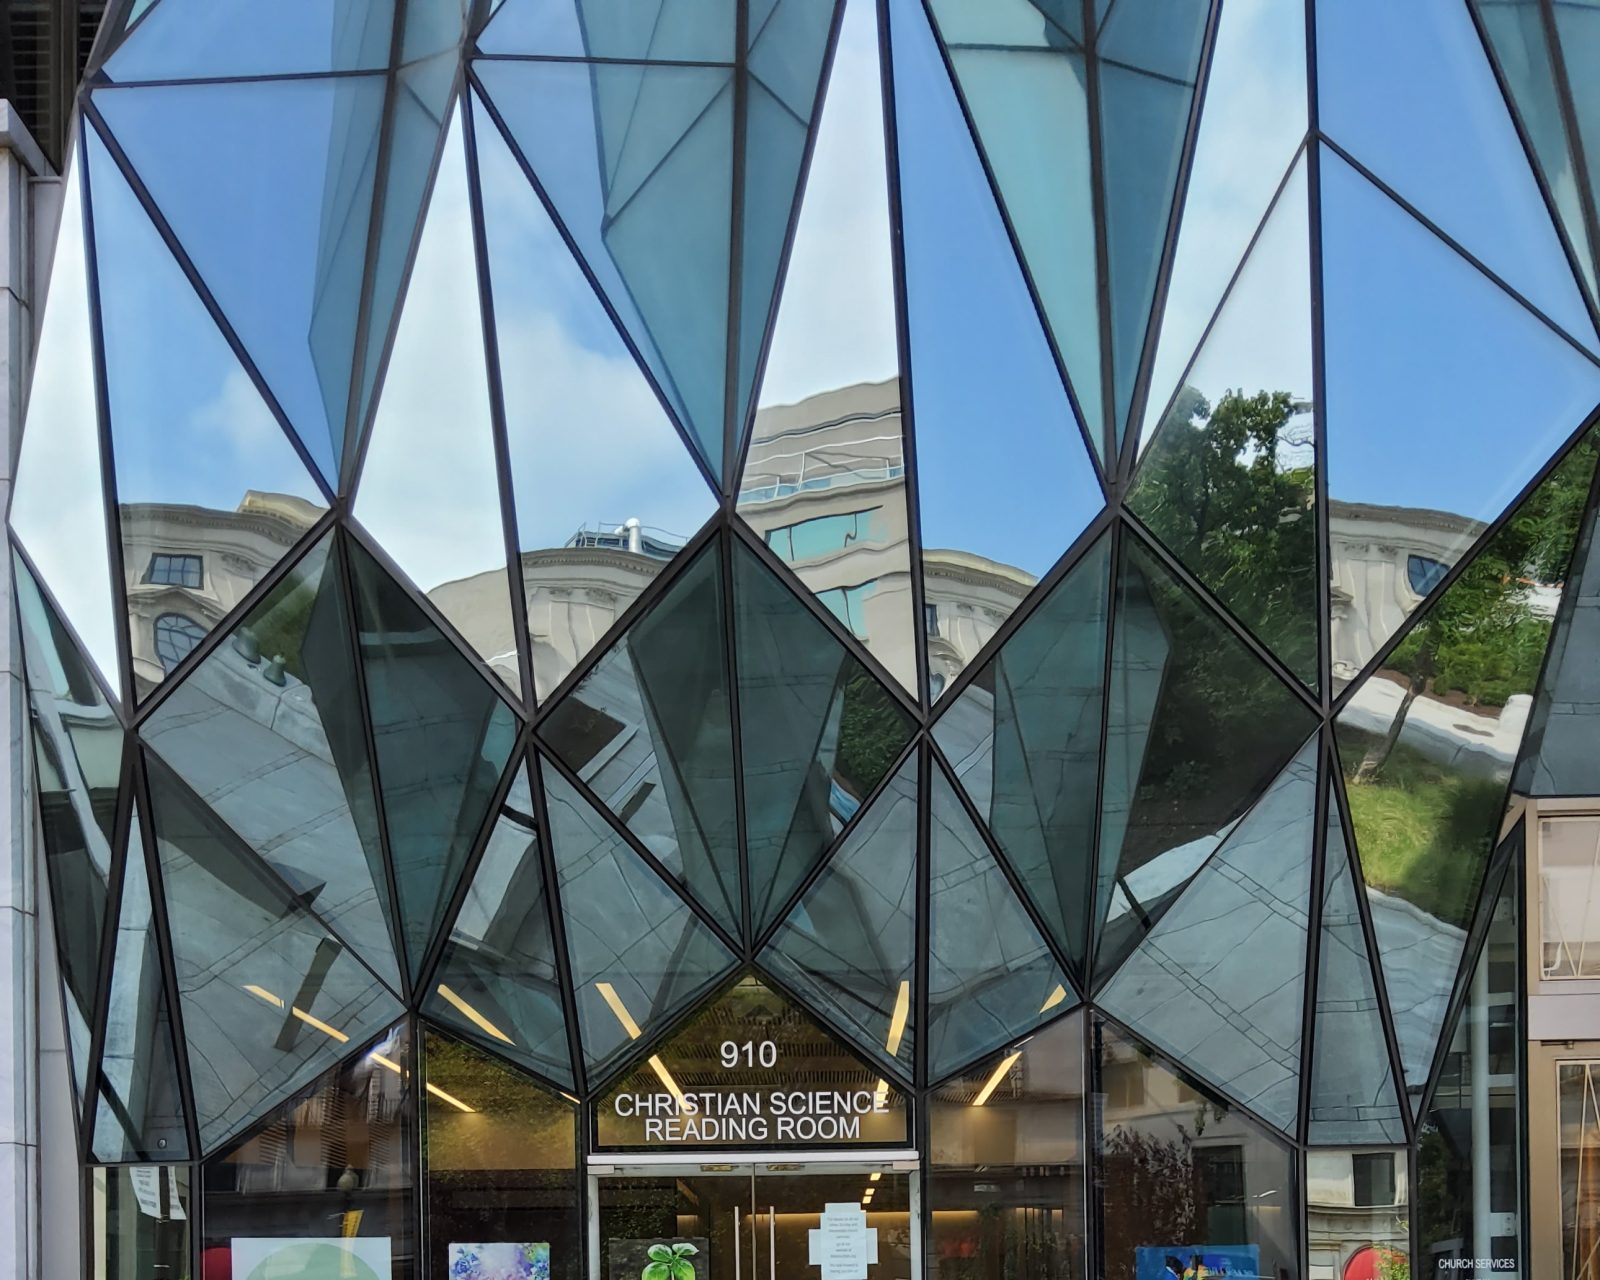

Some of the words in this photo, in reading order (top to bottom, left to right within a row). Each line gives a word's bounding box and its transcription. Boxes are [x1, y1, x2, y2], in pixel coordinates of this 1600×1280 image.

[720, 1040, 777, 1068] 910
[614, 1092, 761, 1117] CHRISTIAN
[769, 1090, 889, 1115] SCIENCE
[645, 1117, 768, 1142] READING
[777, 1116, 860, 1140] ROOM
[1438, 1258, 1473, 1269] CHURCH
[1475, 1258, 1515, 1269] SERVICES
